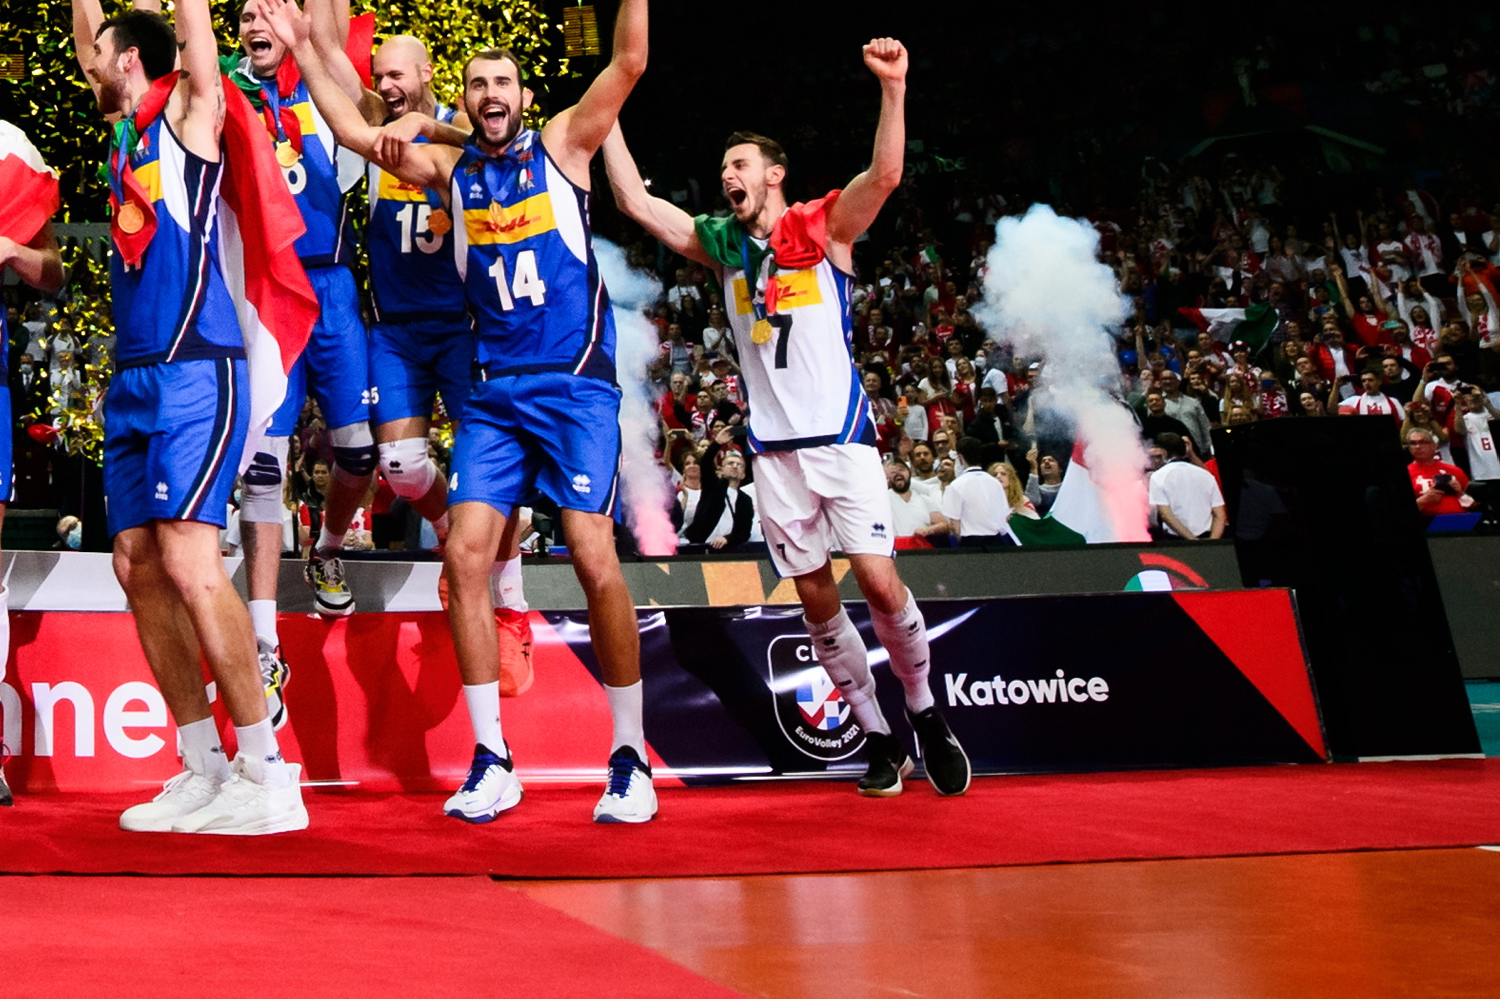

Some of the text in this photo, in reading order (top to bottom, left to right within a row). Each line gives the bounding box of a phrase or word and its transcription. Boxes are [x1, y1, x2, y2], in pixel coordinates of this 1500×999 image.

[280, 155, 307, 195] 6
[396, 203, 444, 254] 15
[488, 249, 547, 312] 14
[767, 314, 794, 369] 7
[776, 543, 789, 563] 7
[945, 669, 1109, 707] Katowice
[795, 723, 861, 749] EuroVolley 2021
